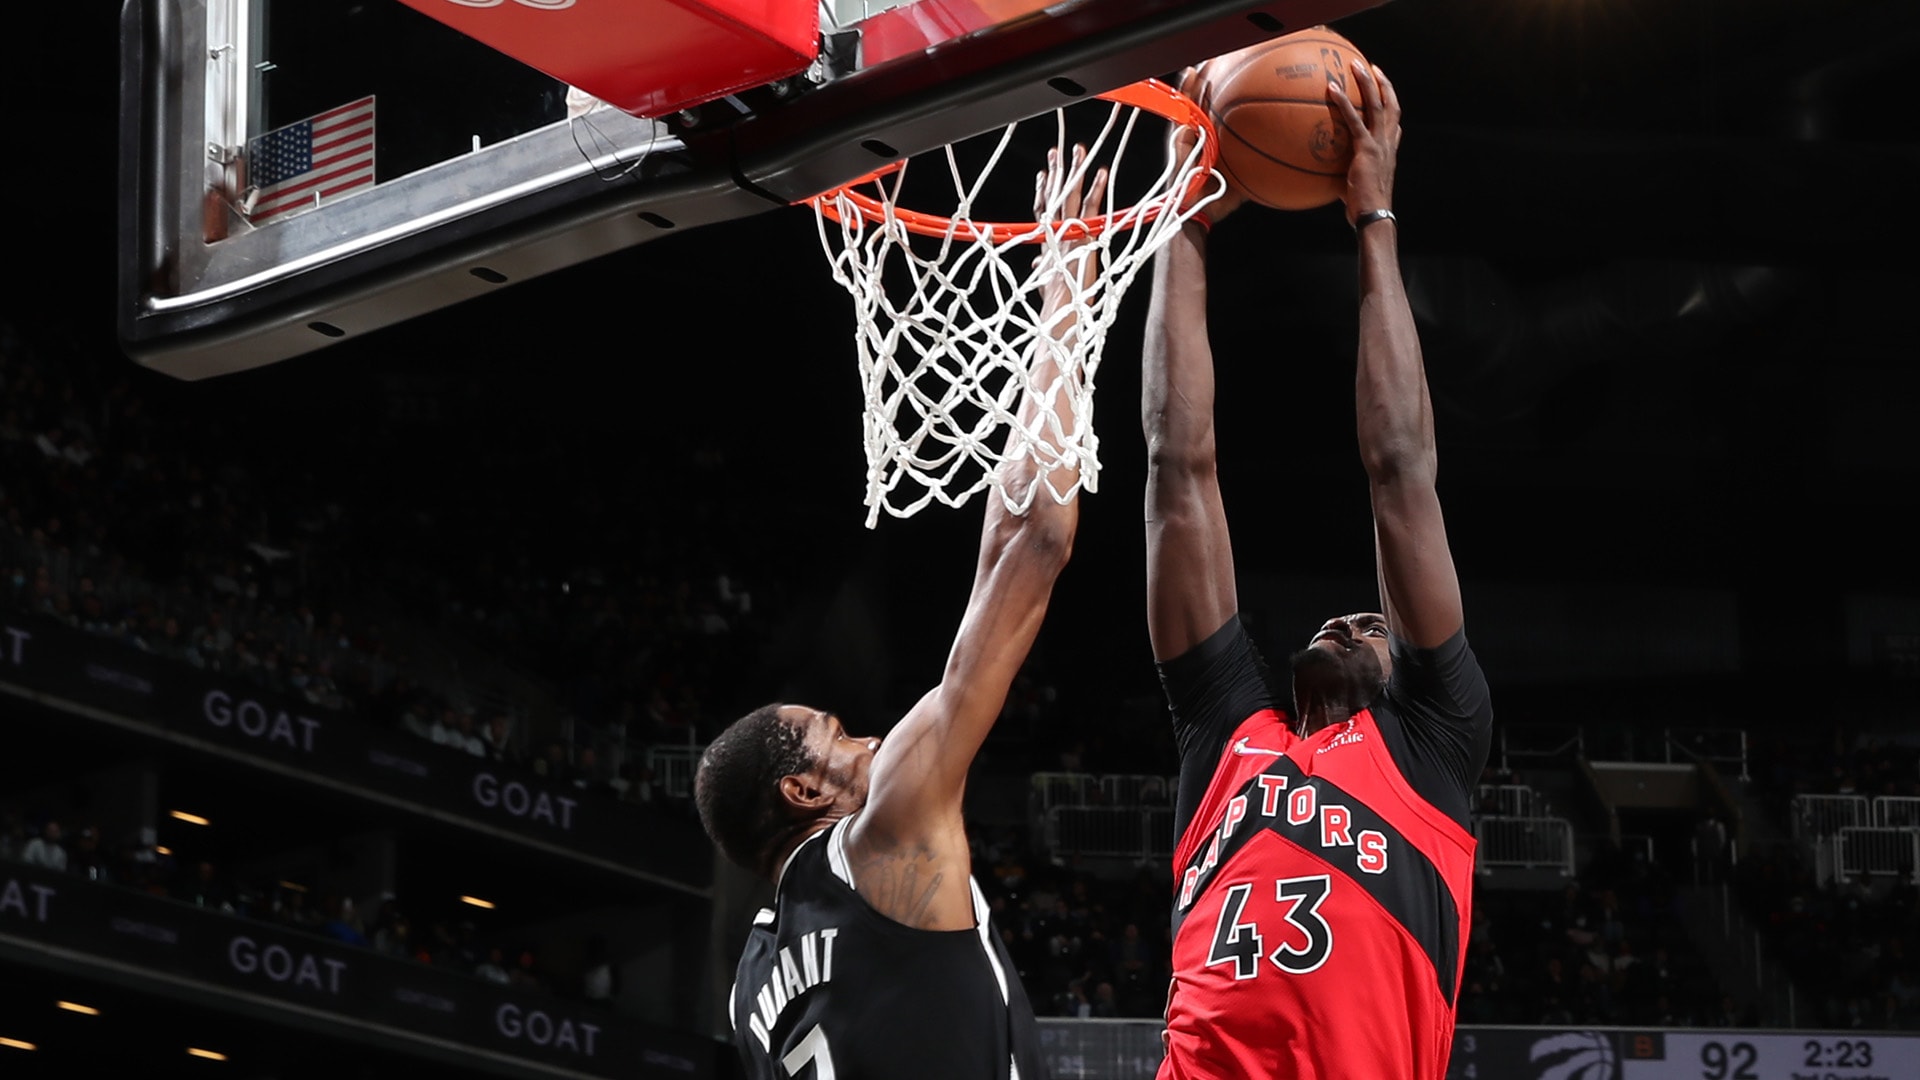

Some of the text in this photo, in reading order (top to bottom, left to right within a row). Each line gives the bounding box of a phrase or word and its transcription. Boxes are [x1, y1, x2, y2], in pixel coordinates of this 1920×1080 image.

[0, 629, 31, 665] T
[203, 689, 320, 753] GOAT
[1340, 732, 1364, 745] Life
[473, 772, 578, 830] GOAT
[1178, 774, 1388, 911] RAPTORS
[1206, 874, 1334, 980] 43
[229, 935, 346, 995] GOAT
[497, 1003, 600, 1058] GOAT
[782, 1023, 837, 1080] 7
[1804, 1040, 1873, 1068] 2:23
[1701, 1042, 1758, 1080] 92
